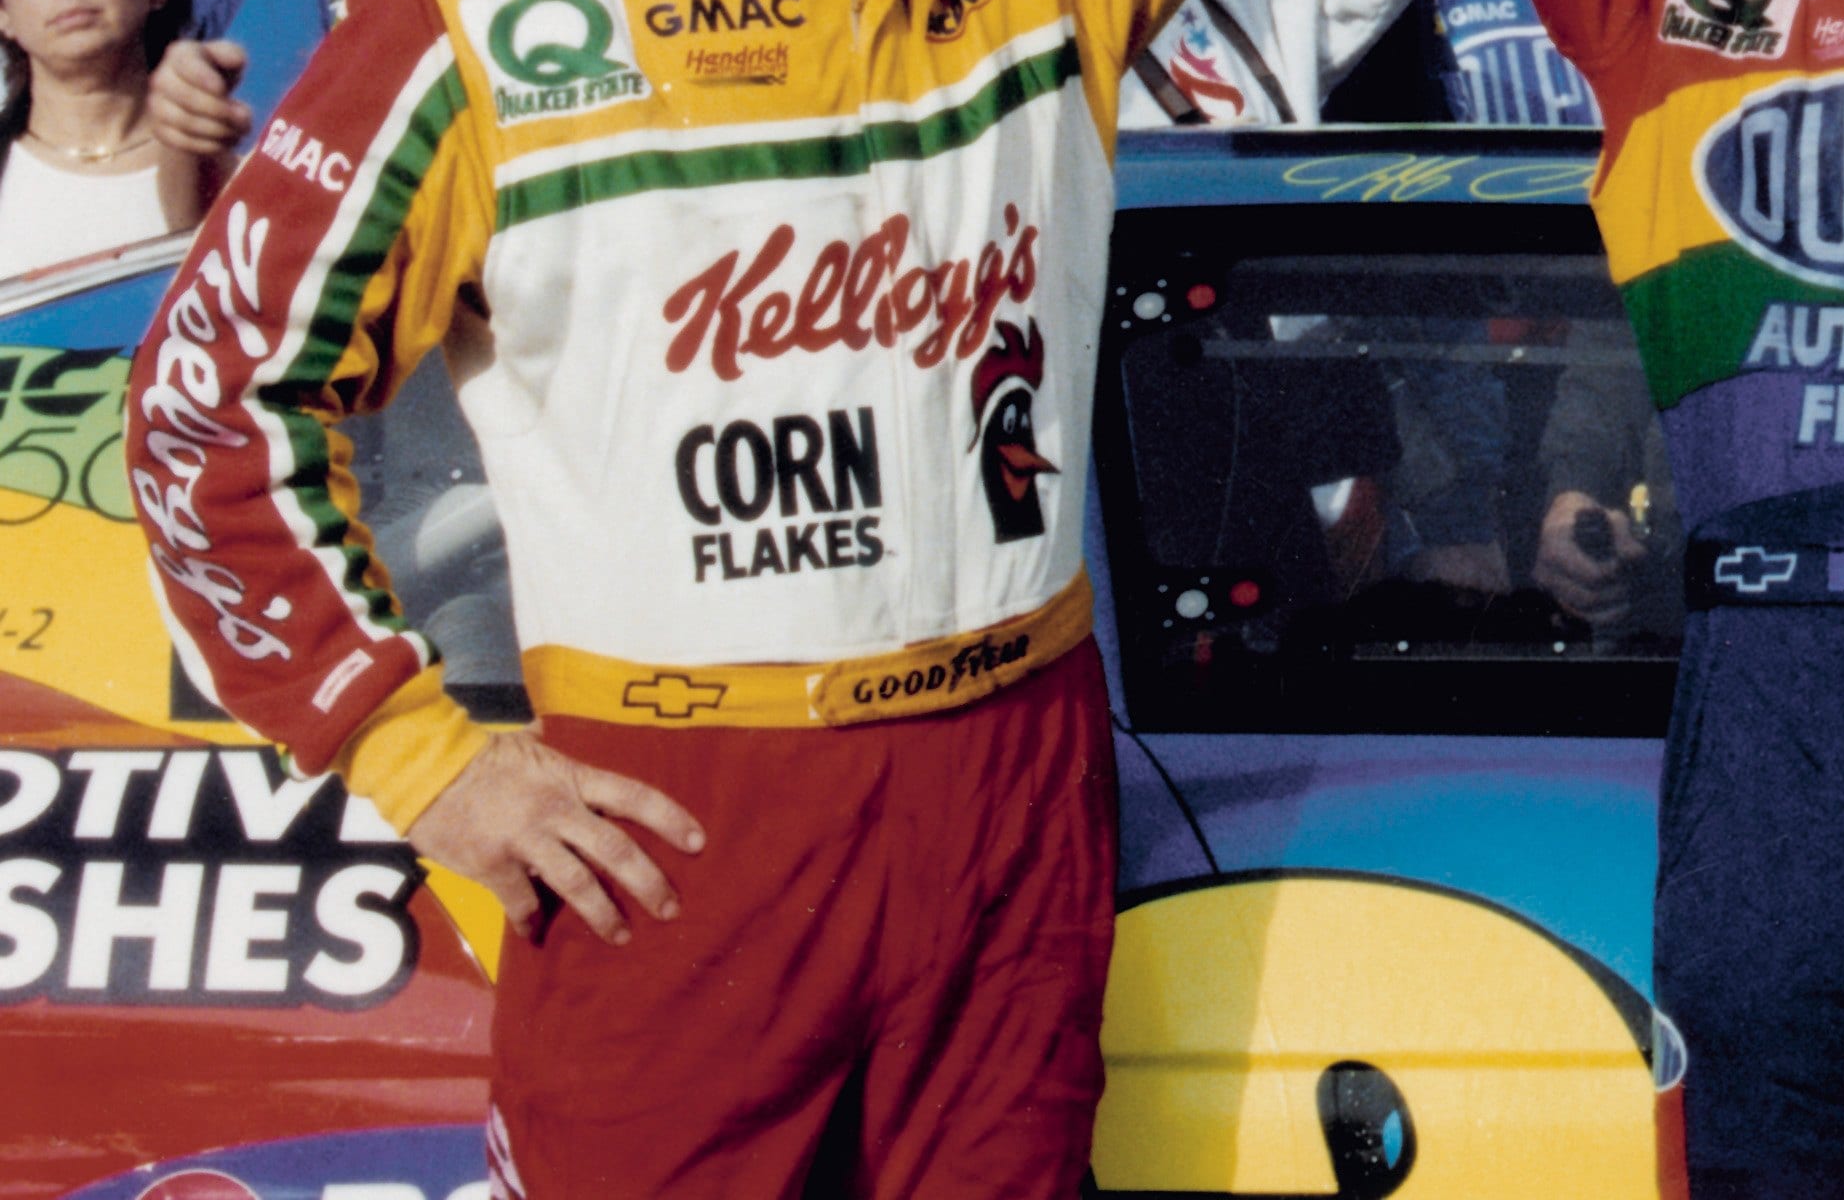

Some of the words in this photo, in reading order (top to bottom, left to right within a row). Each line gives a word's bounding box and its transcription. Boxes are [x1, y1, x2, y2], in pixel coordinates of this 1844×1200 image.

[686, 42, 789, 72] Hendrick
[261, 117, 353, 193] GMAC
[662, 202, 1039, 382] Kellogg's
[133, 199, 292, 665] Kellogg's
[674, 406, 883, 527] CORN
[691, 516, 884, 584] FLAKES
